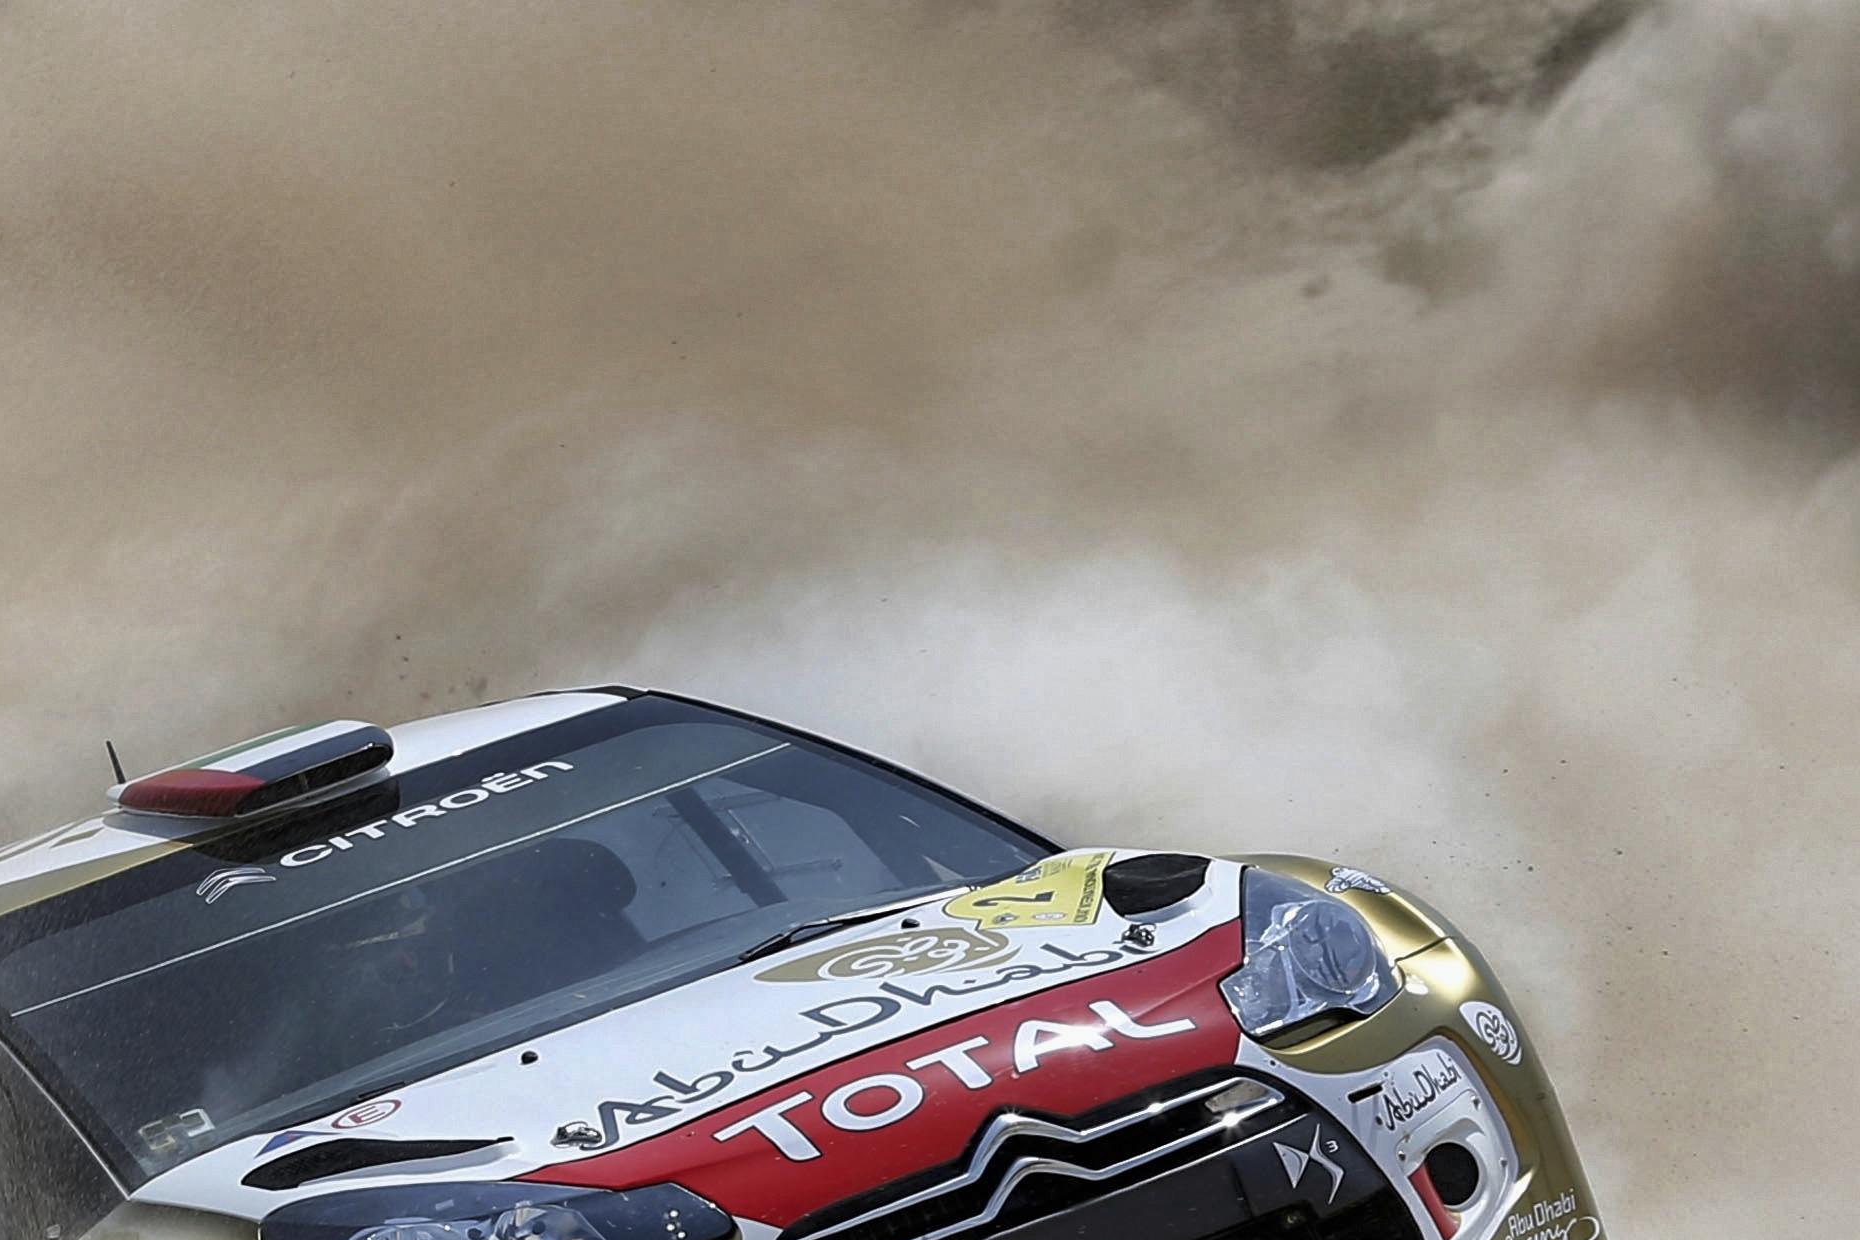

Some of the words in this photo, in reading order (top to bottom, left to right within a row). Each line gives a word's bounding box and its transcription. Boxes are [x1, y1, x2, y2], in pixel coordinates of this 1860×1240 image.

[712, 999, 1196, 1162] TOTAL
[1508, 1208, 1534, 1236] Abu
[1534, 1188, 1577, 1226] Dhabi
